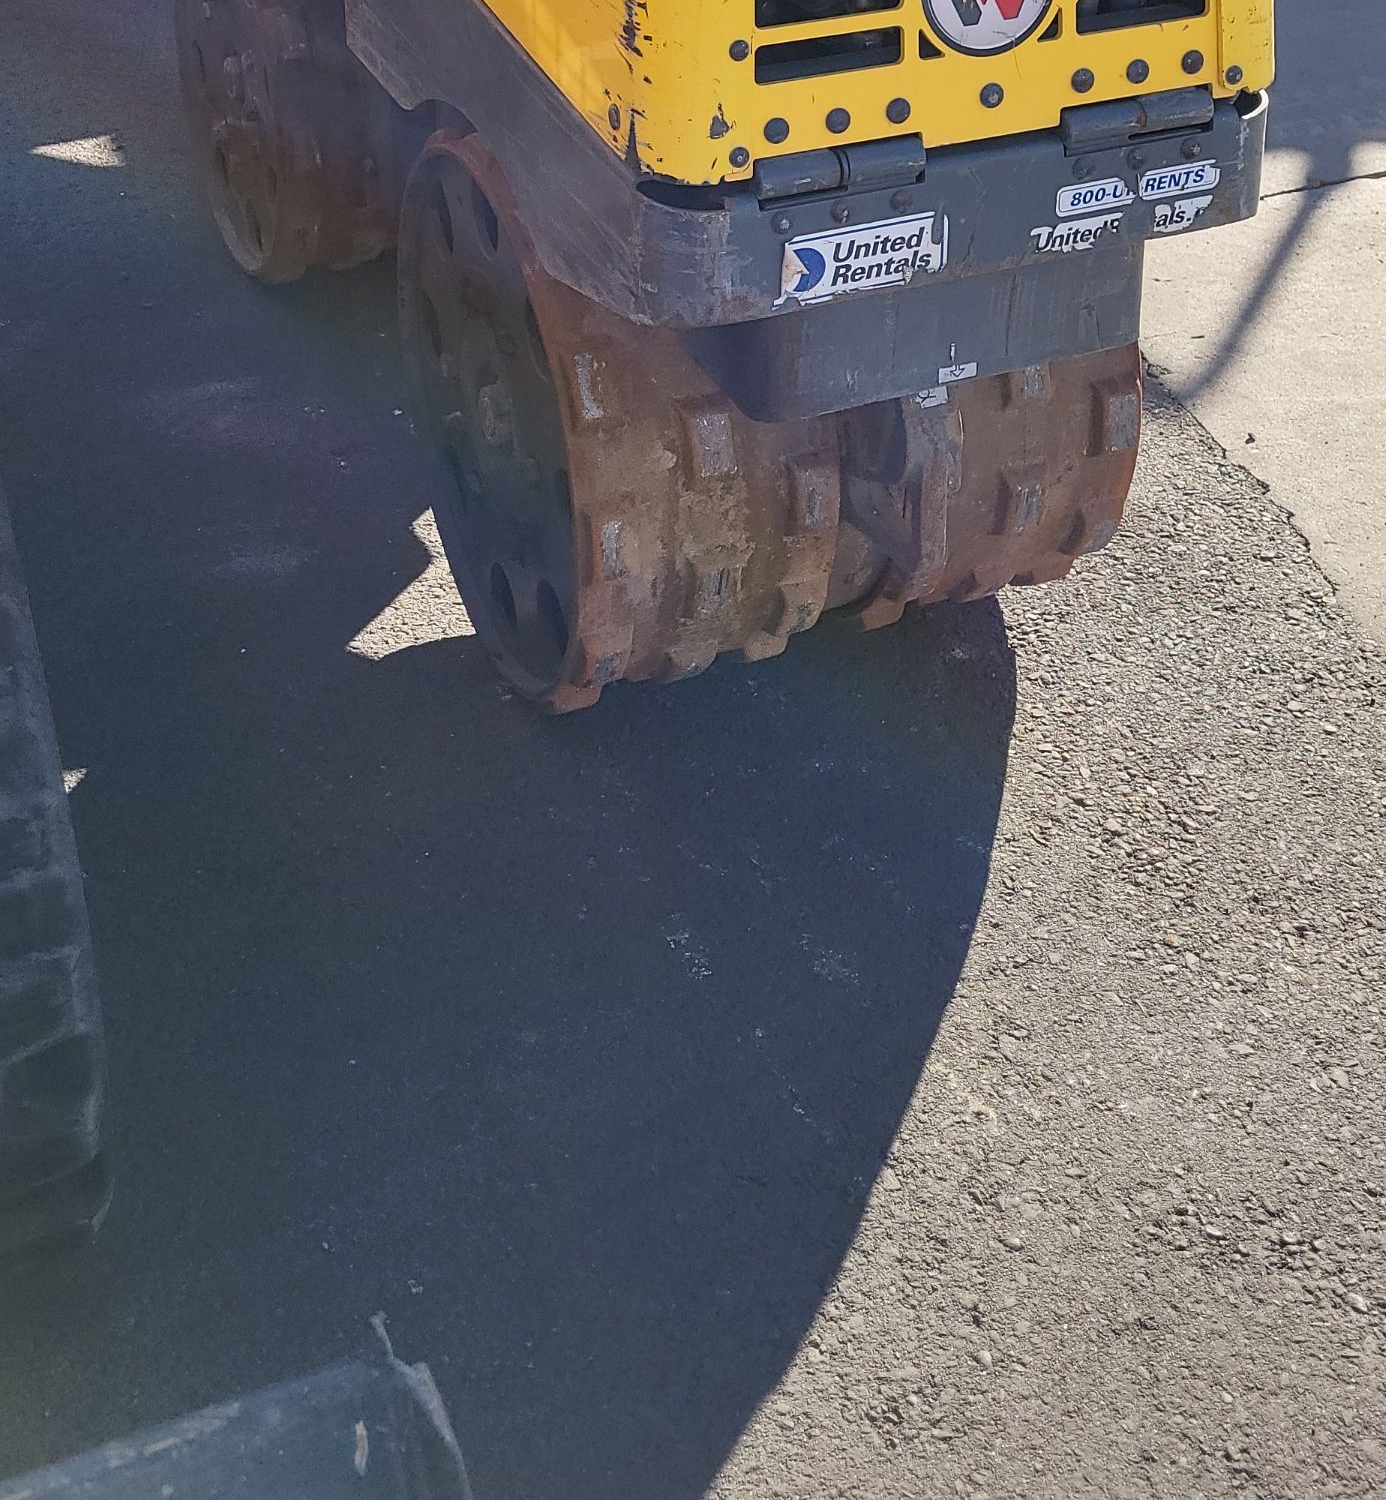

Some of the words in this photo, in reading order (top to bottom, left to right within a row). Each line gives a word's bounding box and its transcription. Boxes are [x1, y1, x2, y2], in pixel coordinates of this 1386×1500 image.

[1070, 168, 1206, 207] 800-URENTS
[833, 226, 925, 262] United
[831, 250, 932, 287] Rentals
